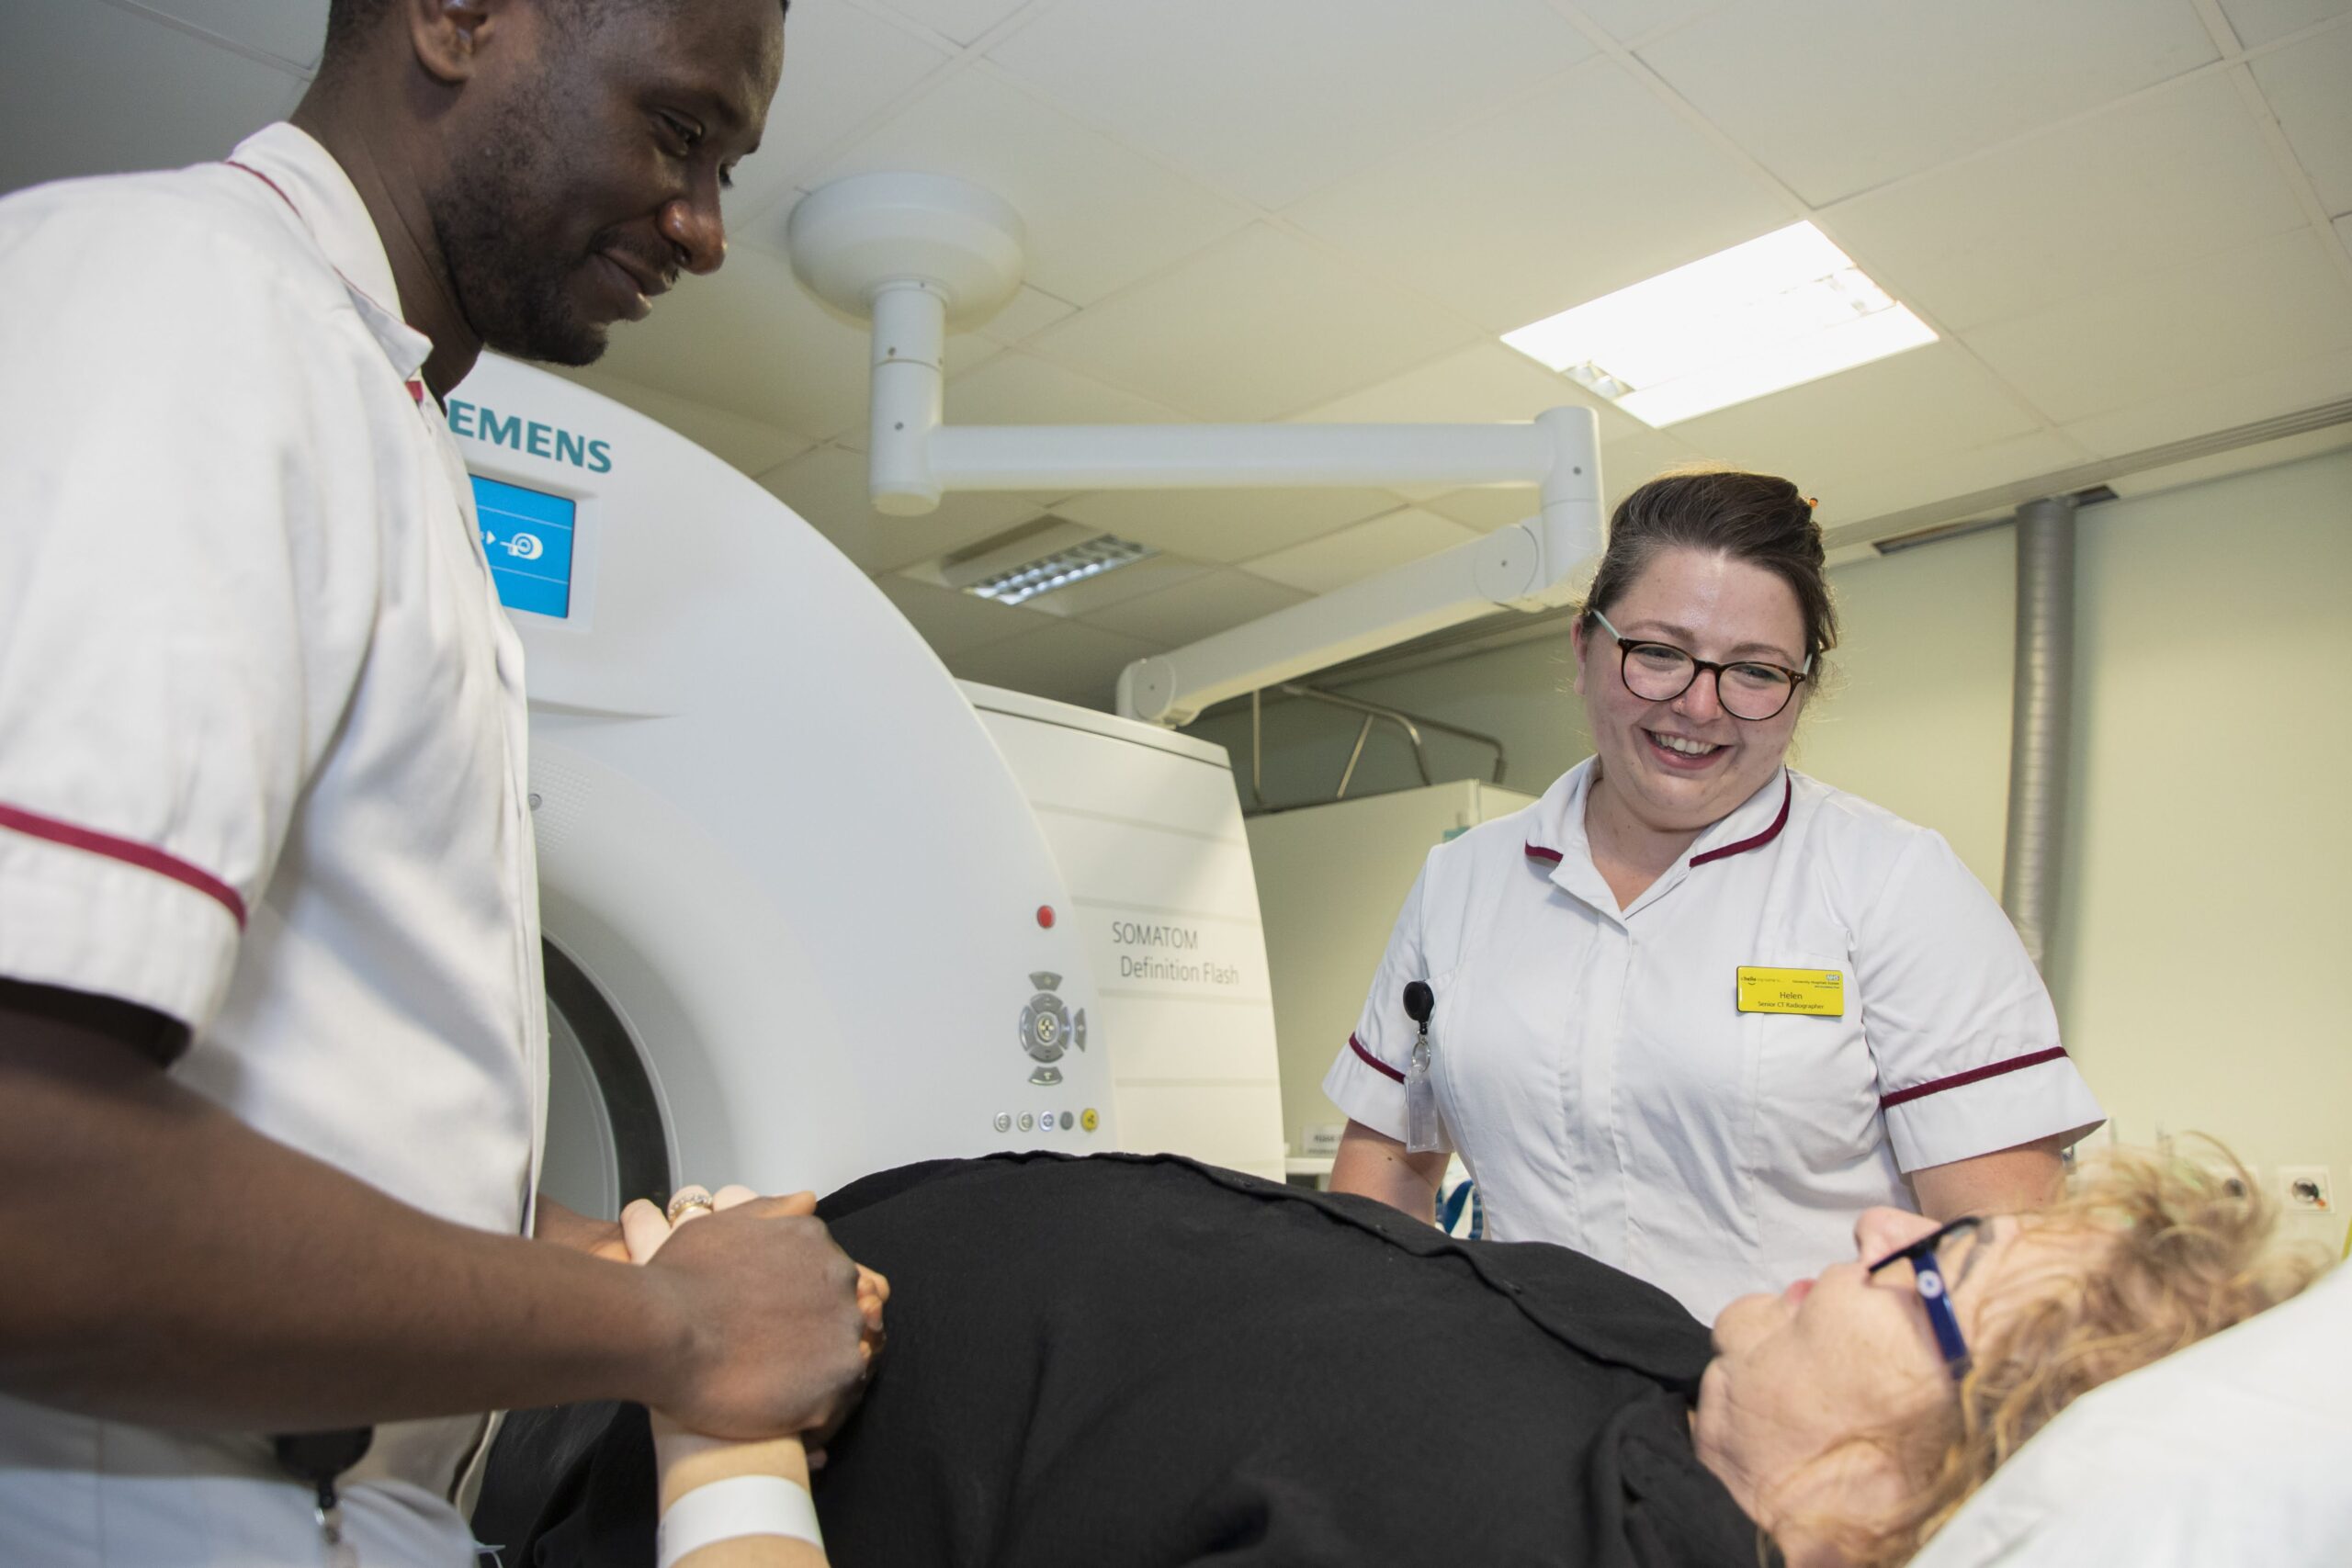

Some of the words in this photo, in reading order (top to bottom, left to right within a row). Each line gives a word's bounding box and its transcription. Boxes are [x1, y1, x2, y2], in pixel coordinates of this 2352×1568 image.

[448, 399, 612, 473] EMENS
[1112, 921, 1199, 950] SOMATOM
[1121, 955, 1200, 982] Definition
[1203, 962, 1240, 985] Flash
[1779, 991, 1803, 1000] Helen
